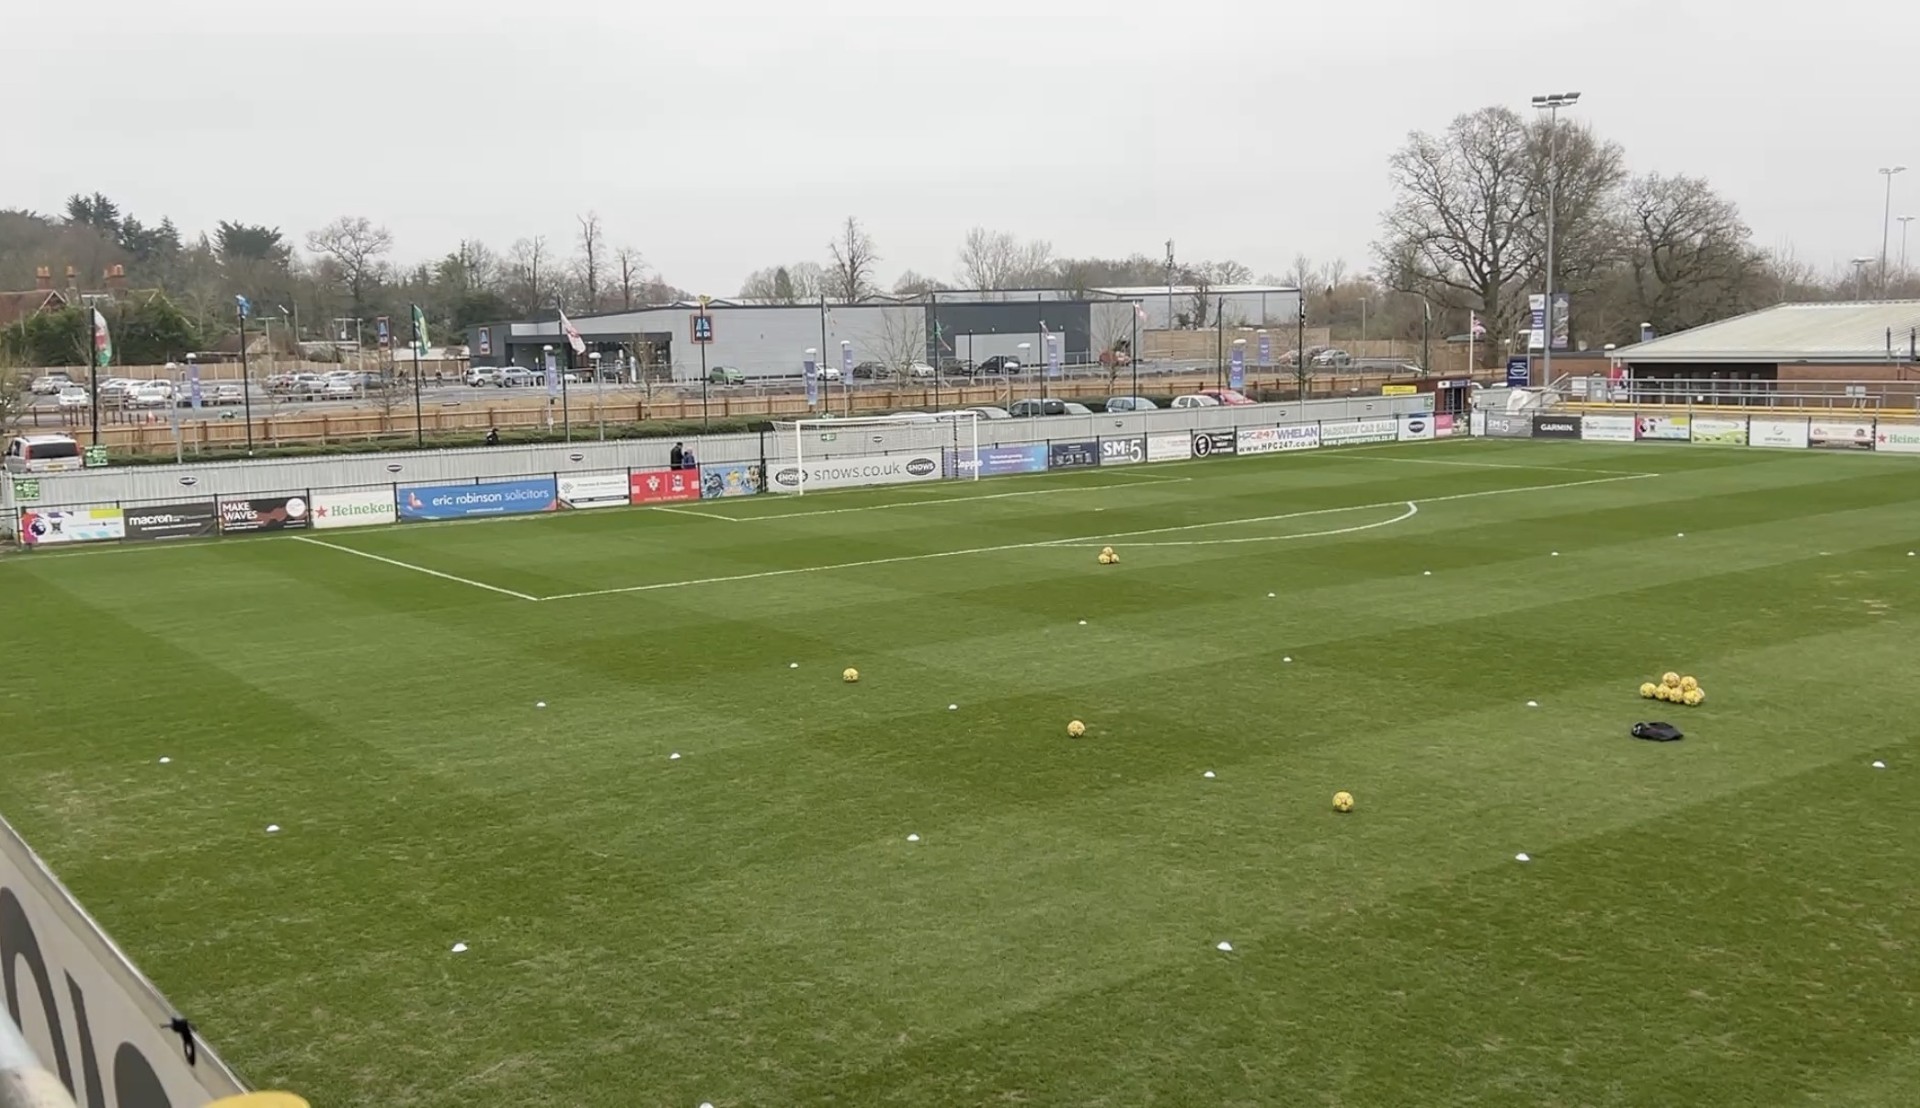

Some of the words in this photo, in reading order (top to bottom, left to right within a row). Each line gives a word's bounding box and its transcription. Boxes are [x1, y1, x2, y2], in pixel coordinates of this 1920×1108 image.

[1276, 427, 1318, 440] WHELAN
[1238, 439, 1318, 453] www.HPC247.co.uk
[813, 461, 901, 481] snows.co.uk
[907, 462, 934, 473] SNOWS
[432, 494, 453, 506] eric
[455, 492, 503, 505] robinson
[504, 488, 550, 501] solicitors
[222, 501, 250, 512] MAKE
[331, 502, 394, 517] Heineken
[128, 513, 173, 526] macron
[223, 510, 258, 521] WAVES
